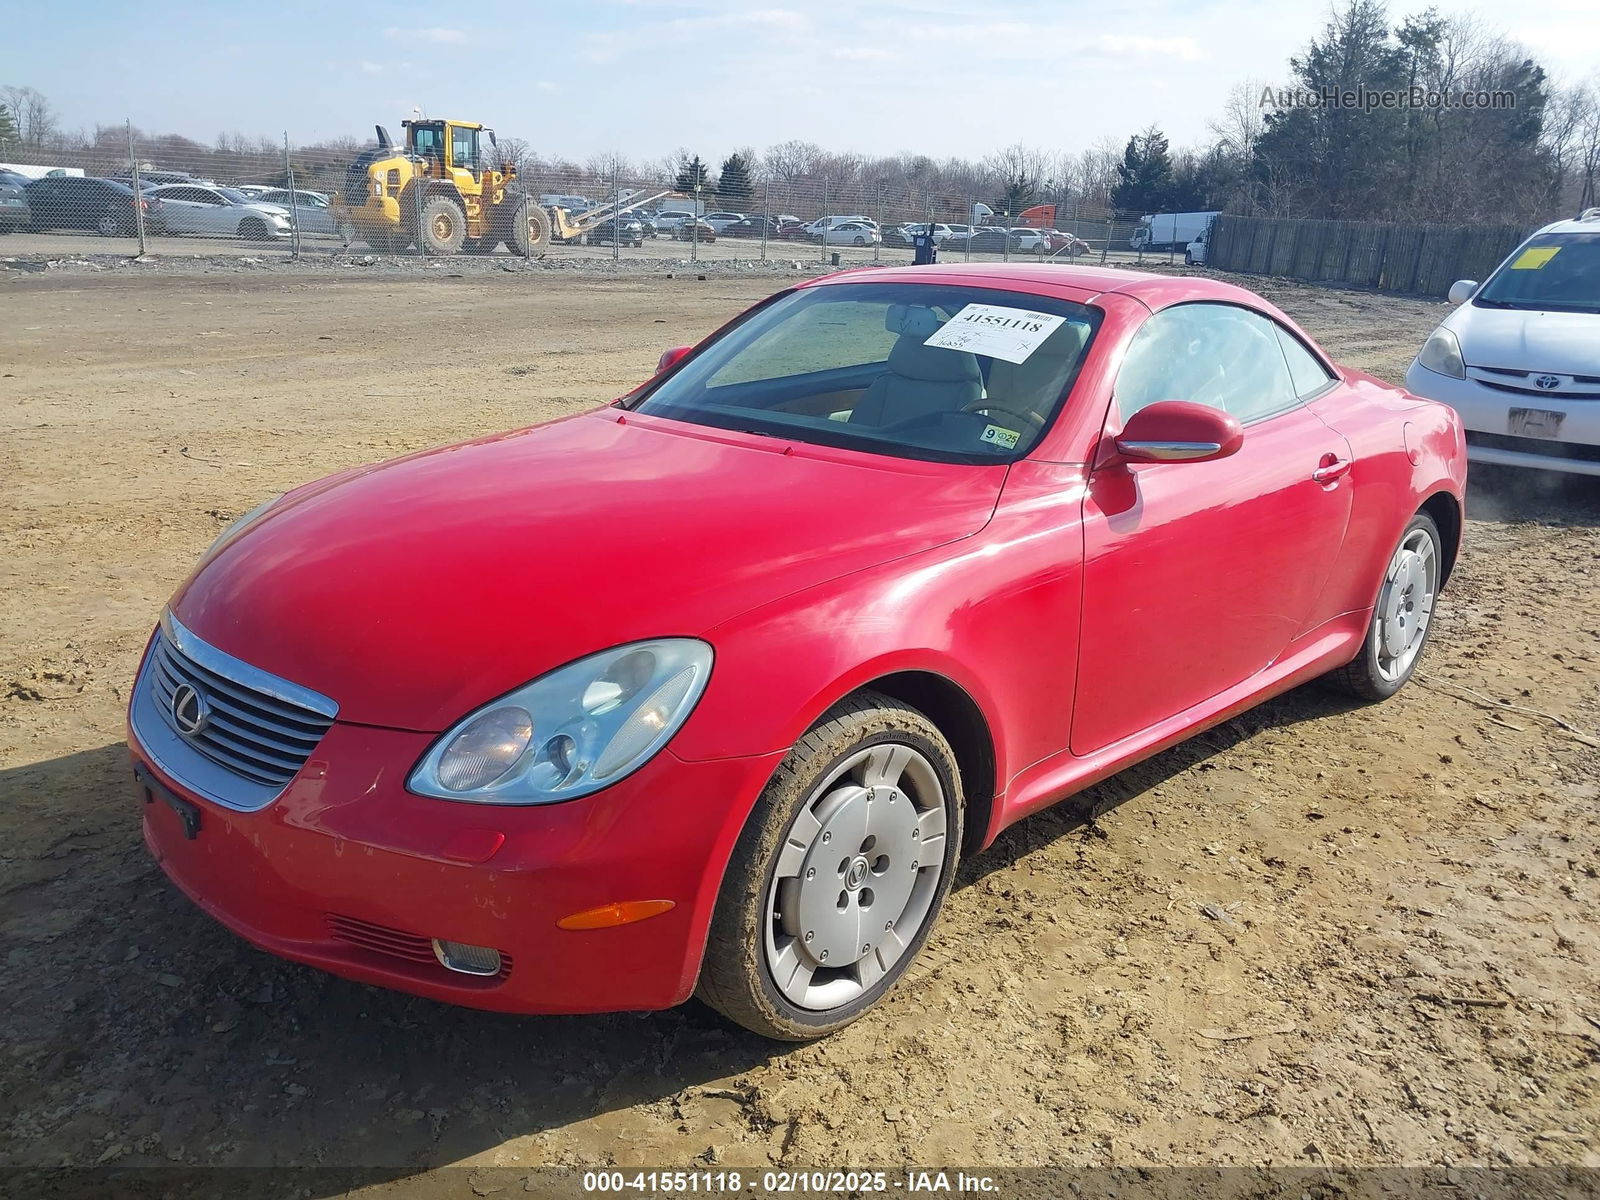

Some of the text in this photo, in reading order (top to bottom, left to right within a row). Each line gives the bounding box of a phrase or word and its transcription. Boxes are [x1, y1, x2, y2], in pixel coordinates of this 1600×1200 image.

[963, 313, 1043, 333] 41551118
[985, 429, 1018, 443] 9 25
